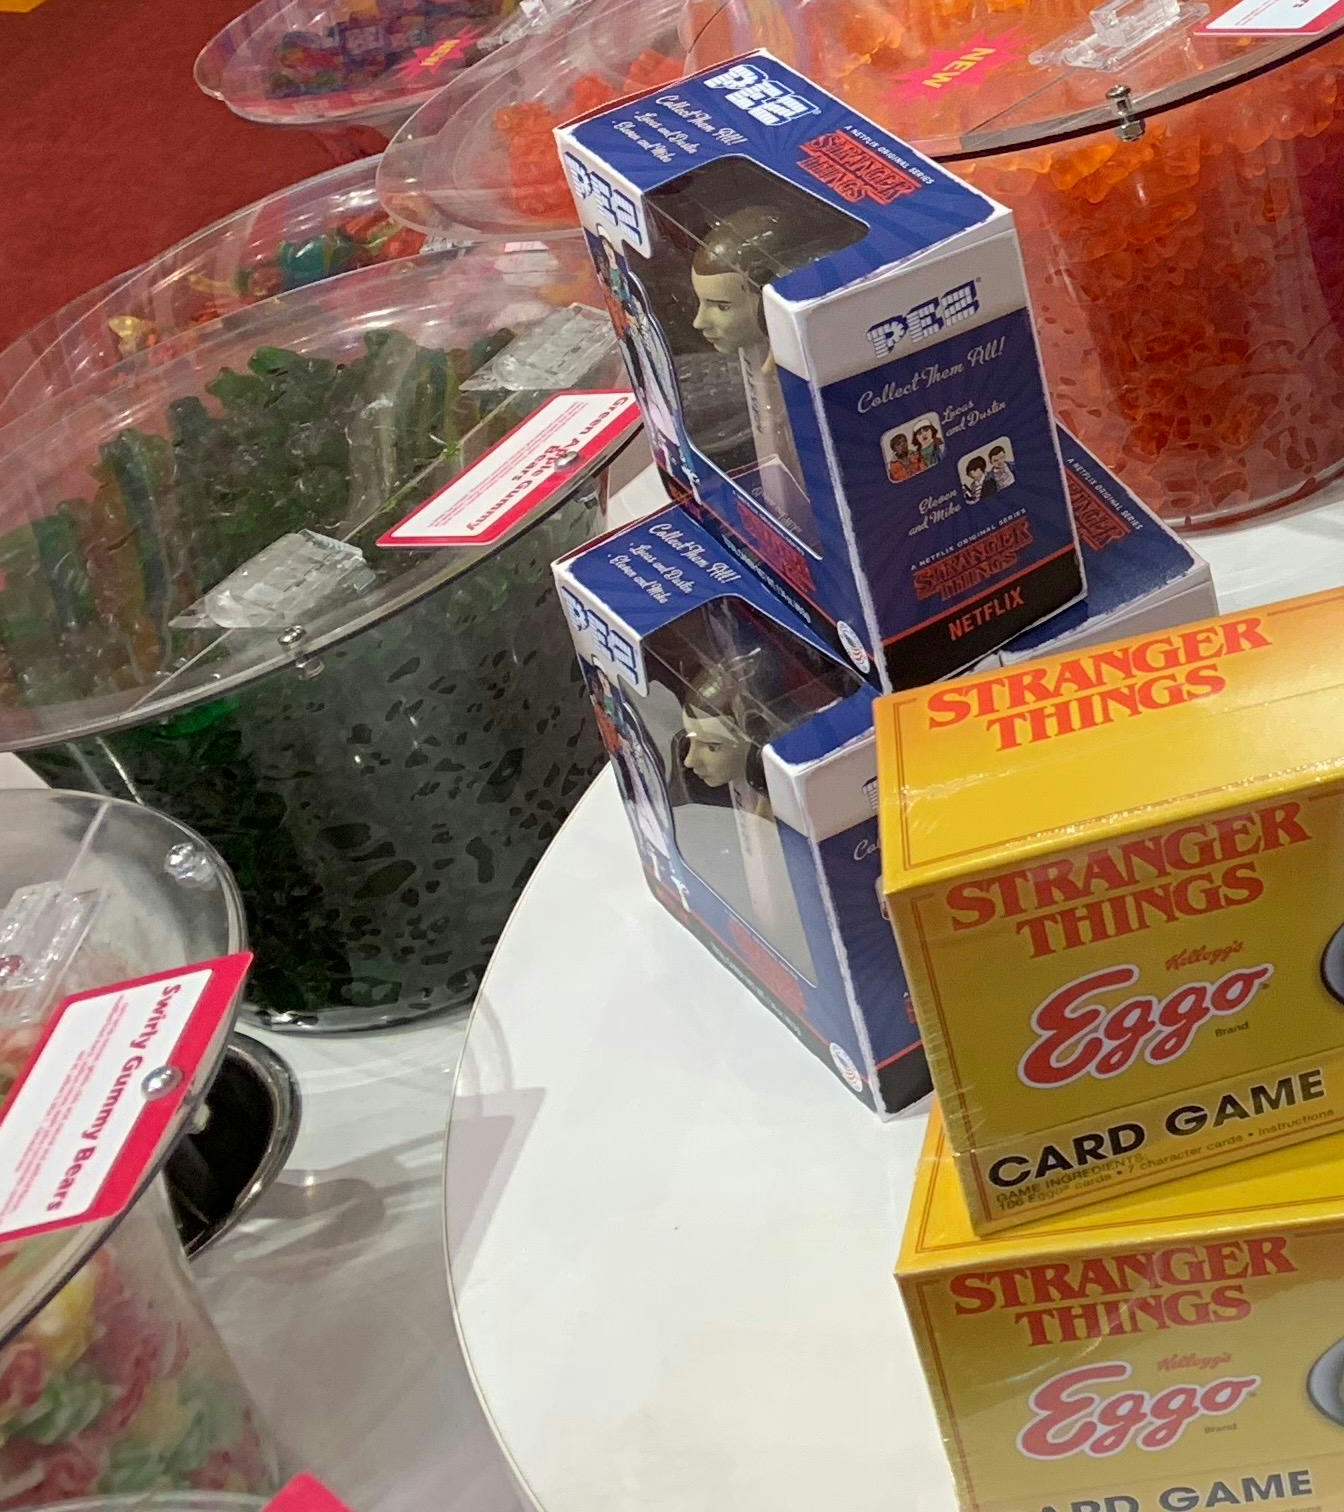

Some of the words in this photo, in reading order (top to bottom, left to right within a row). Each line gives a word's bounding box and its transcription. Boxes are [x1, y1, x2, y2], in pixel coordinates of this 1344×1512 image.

[921, 45, 996, 89] NEW
[866, 279, 980, 359] PEZ
[857, 375, 921, 415] Collect
[921, 361, 965, 388] Them
[941, 398, 975, 425] Lucas
[946, 419, 966, 437] and
[966, 401, 1007, 427] Dustin
[908, 518, 929, 536] and
[929, 503, 962, 524] Mike
[919, 489, 957, 514] Eleven
[948, 588, 1024, 641] NETFLIX
[926, 616, 1273, 731] STRANGER
[985, 664, 1227, 751] THINGS
[944, 800, 1312, 932] STRANGER
[1015, 861, 1264, 959] THINGS
[1164, 939, 1245, 970] Kellogg's
[127, 983, 183, 1052] Swirly
[1017, 962, 1274, 1088] Eggo
[79, 1053, 147, 1141] Gummy
[988, 1122, 1146, 1188] CARD
[1164, 1069, 1326, 1137] GAME
[46, 1144, 97, 1212] Bears
[948, 1234, 1299, 1317] STRANGER
[1013, 1284, 1253, 1349] THINGS
[1016, 1360, 1261, 1461] Eggo
